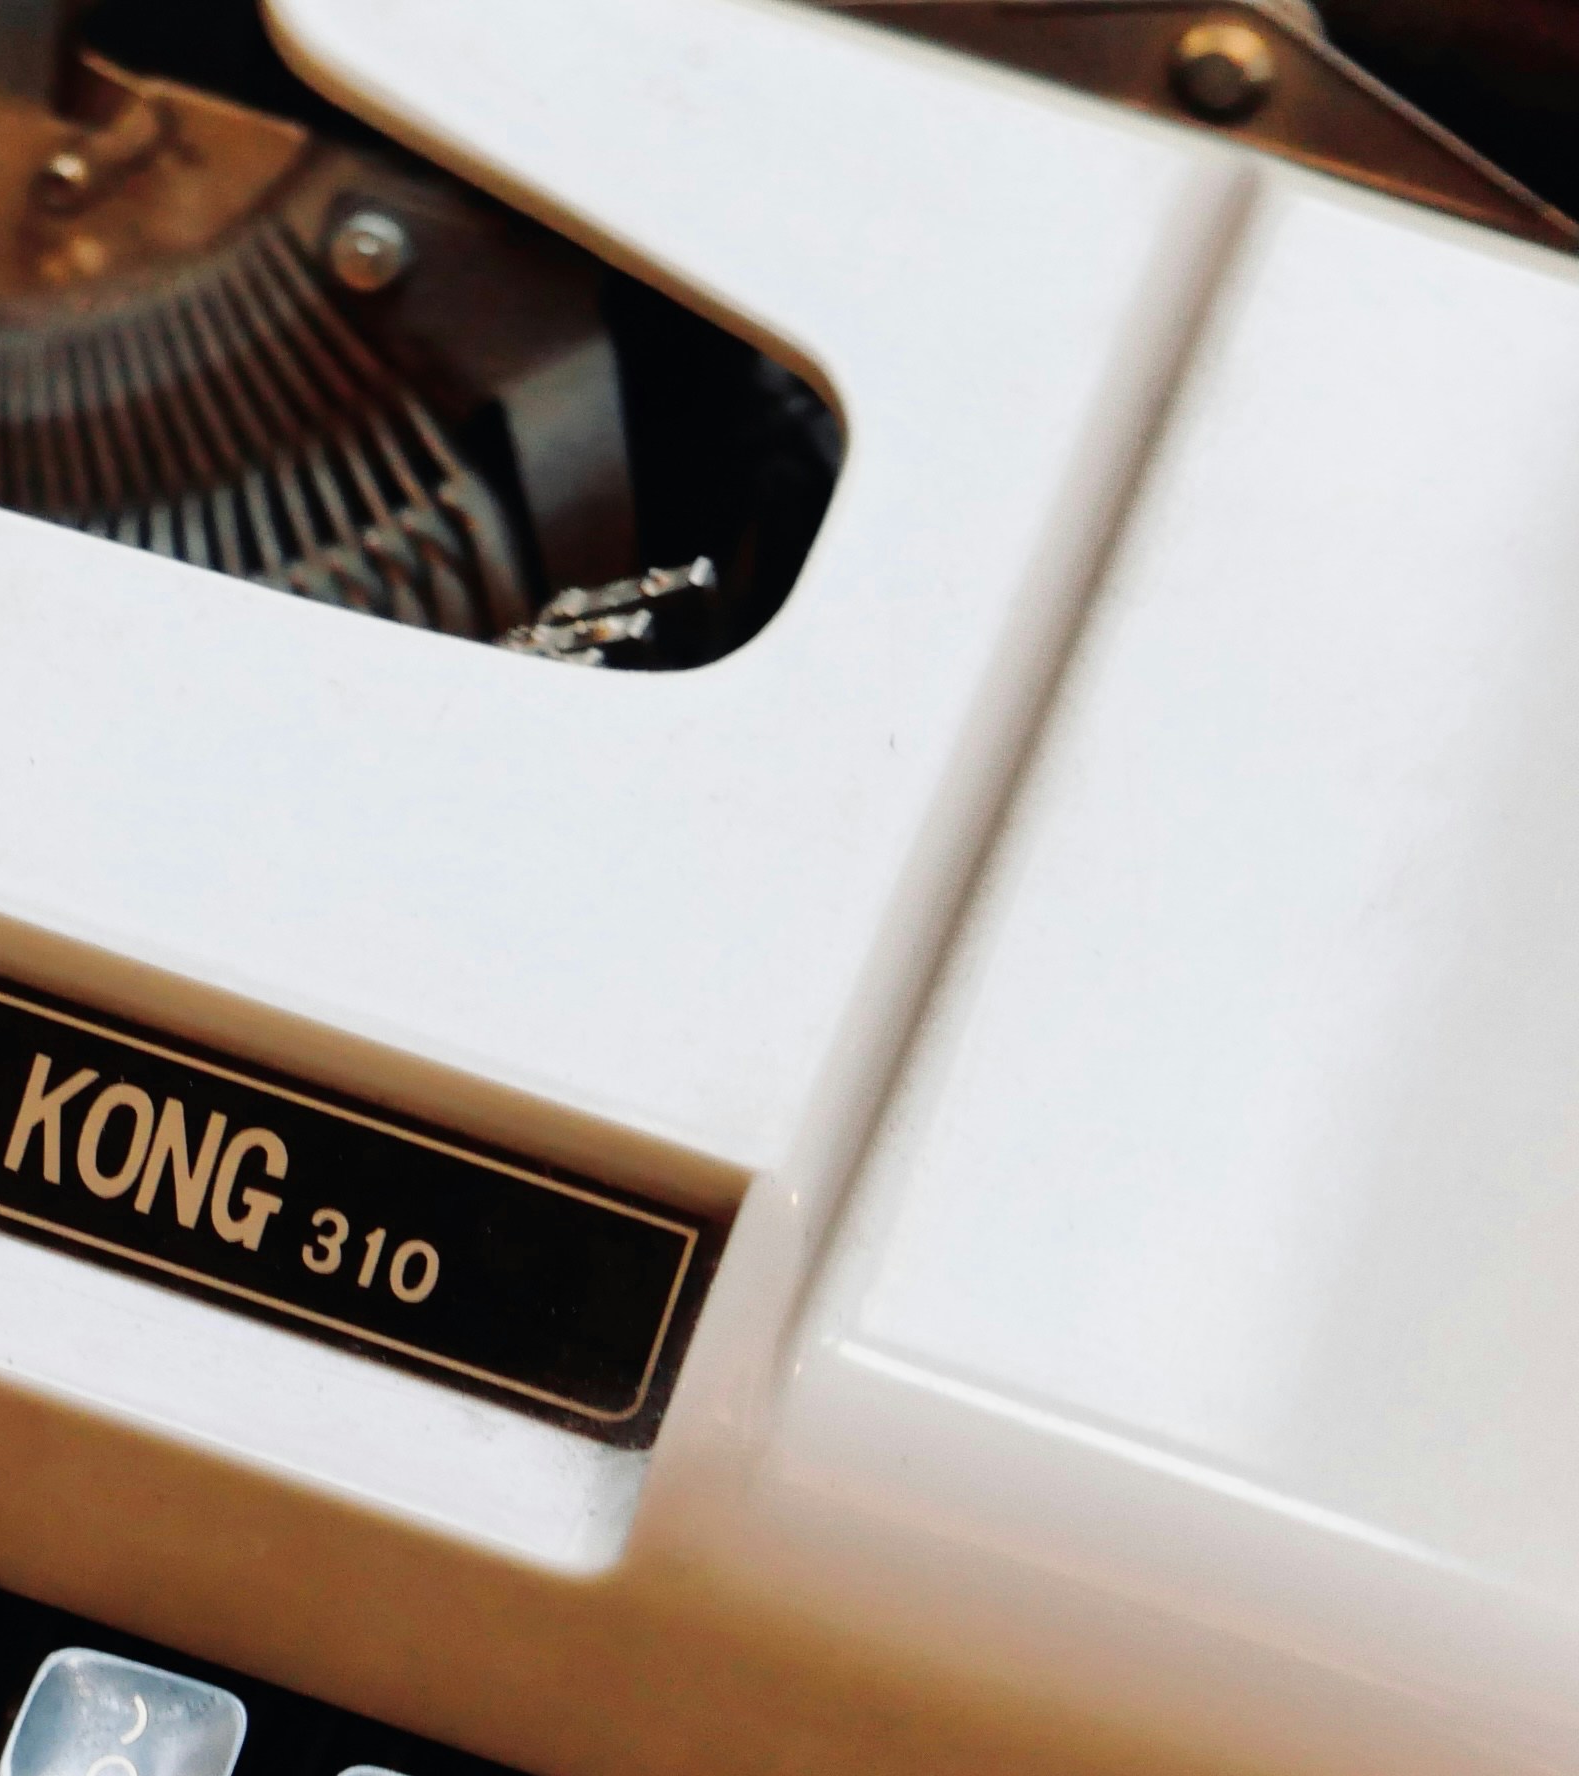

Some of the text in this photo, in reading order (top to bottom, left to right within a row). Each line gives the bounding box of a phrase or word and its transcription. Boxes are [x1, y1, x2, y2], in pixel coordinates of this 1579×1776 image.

[3, 1052, 289, 1252] KONG
[301, 1207, 441, 1305] 310
[119, 1695, 148, 1745] )
